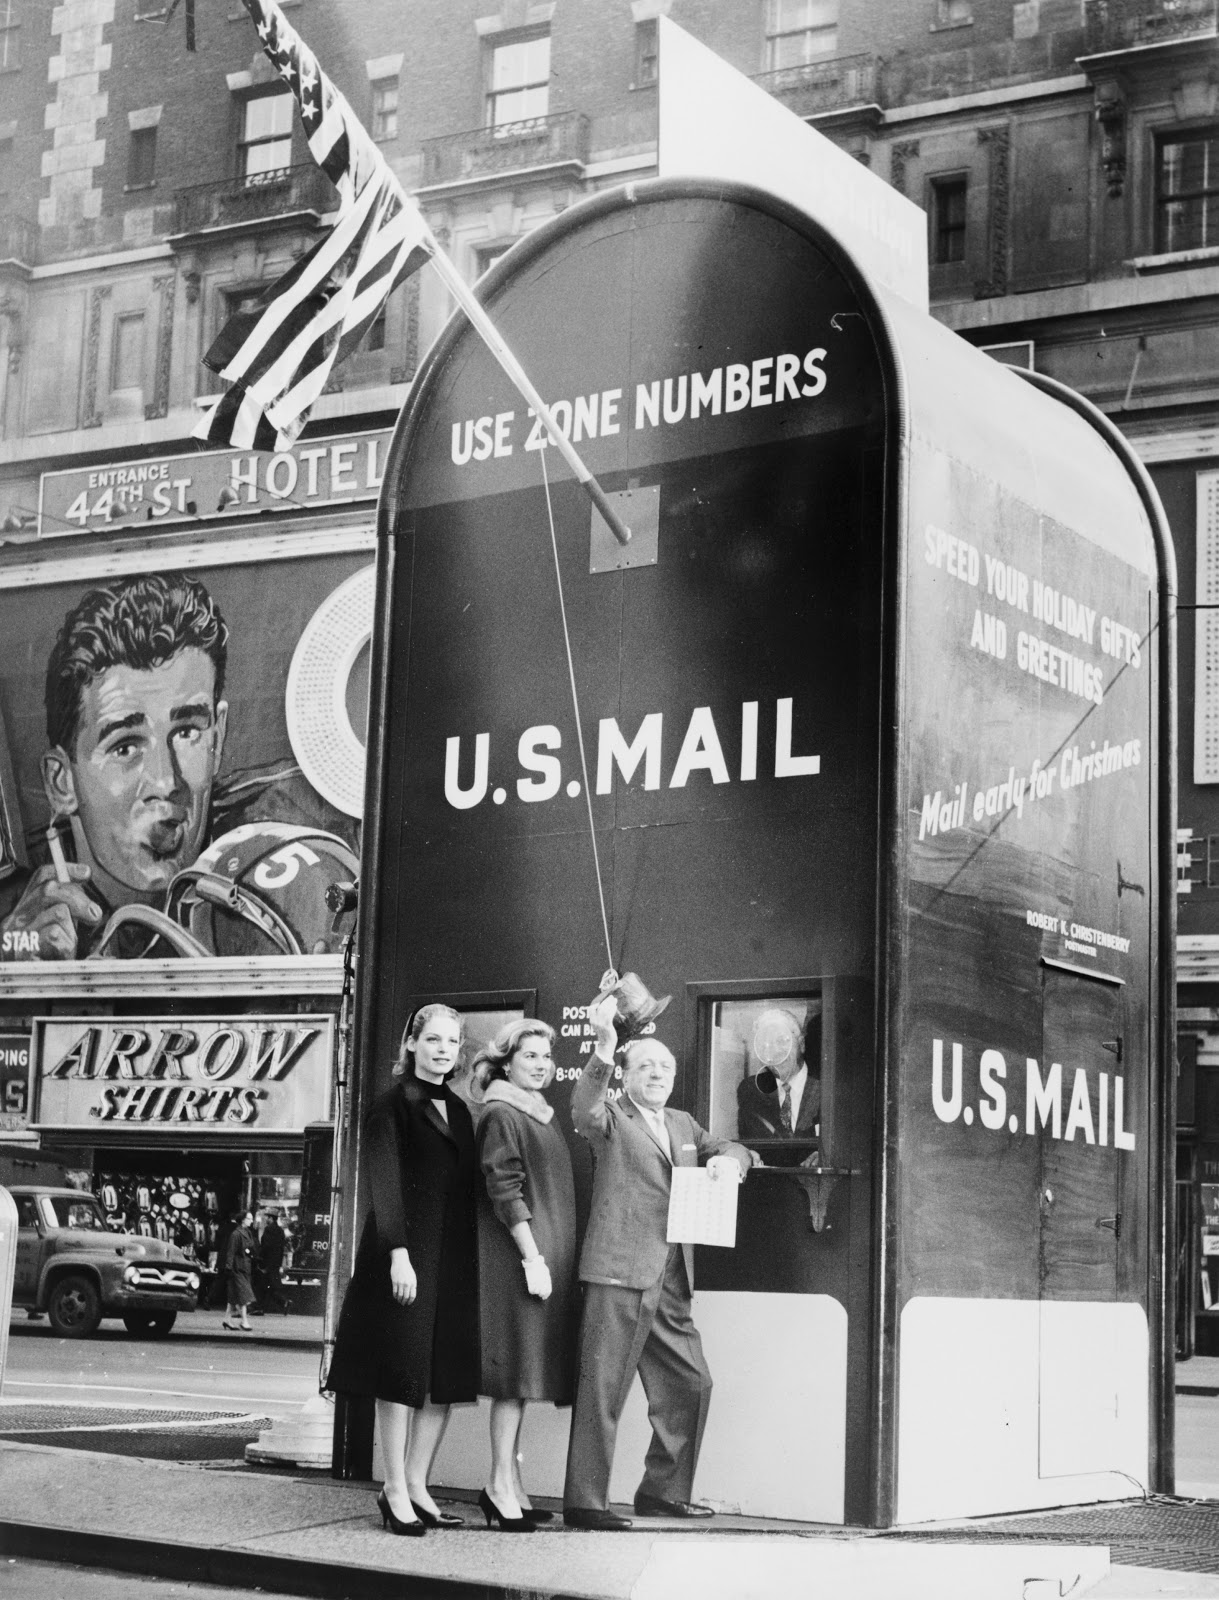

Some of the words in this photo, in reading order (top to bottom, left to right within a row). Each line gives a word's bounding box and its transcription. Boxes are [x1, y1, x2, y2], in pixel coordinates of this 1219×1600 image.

[450, 410, 515, 466] USE
[523, 387, 622, 452] ZONE
[635, 347, 828, 431] NUMBERS
[88, 464, 170, 489] ENTRANCE
[230, 440, 382, 506] HOTEL
[152, 478, 192, 517] ST
[924, 523, 980, 587] SPEED
[984, 553, 1029, 613] YOUR
[1032, 579, 1097, 645] HOLIDAY
[1100, 615, 1141, 669] GIFTS
[970, 609, 1008, 660] AND
[1016, 630, 1104, 705] GREETINGS
[918, 781, 968, 841] Mail
[972, 765, 1026, 819] early
[1029, 758, 1057, 801] for
[1059, 738, 1141, 790] Christmas
[254, 841, 321, 889] 5
[2, 930, 41, 952] STAR
[1026, 909, 1059, 933] ROBERT
[1060, 920, 1070, 937] K.
[1070, 922, 1131, 954] CHRISTENBERRY
[1064, 939, 1098, 958] POSTMASTER
[561, 1023, 582, 1037] CAN
[562, 1006, 591, 1020] POST
[44, 1027, 315, 1081] ARROW
[579, 1041, 592, 1054] AT
[89, 1085, 264, 1124] SHIRTS
